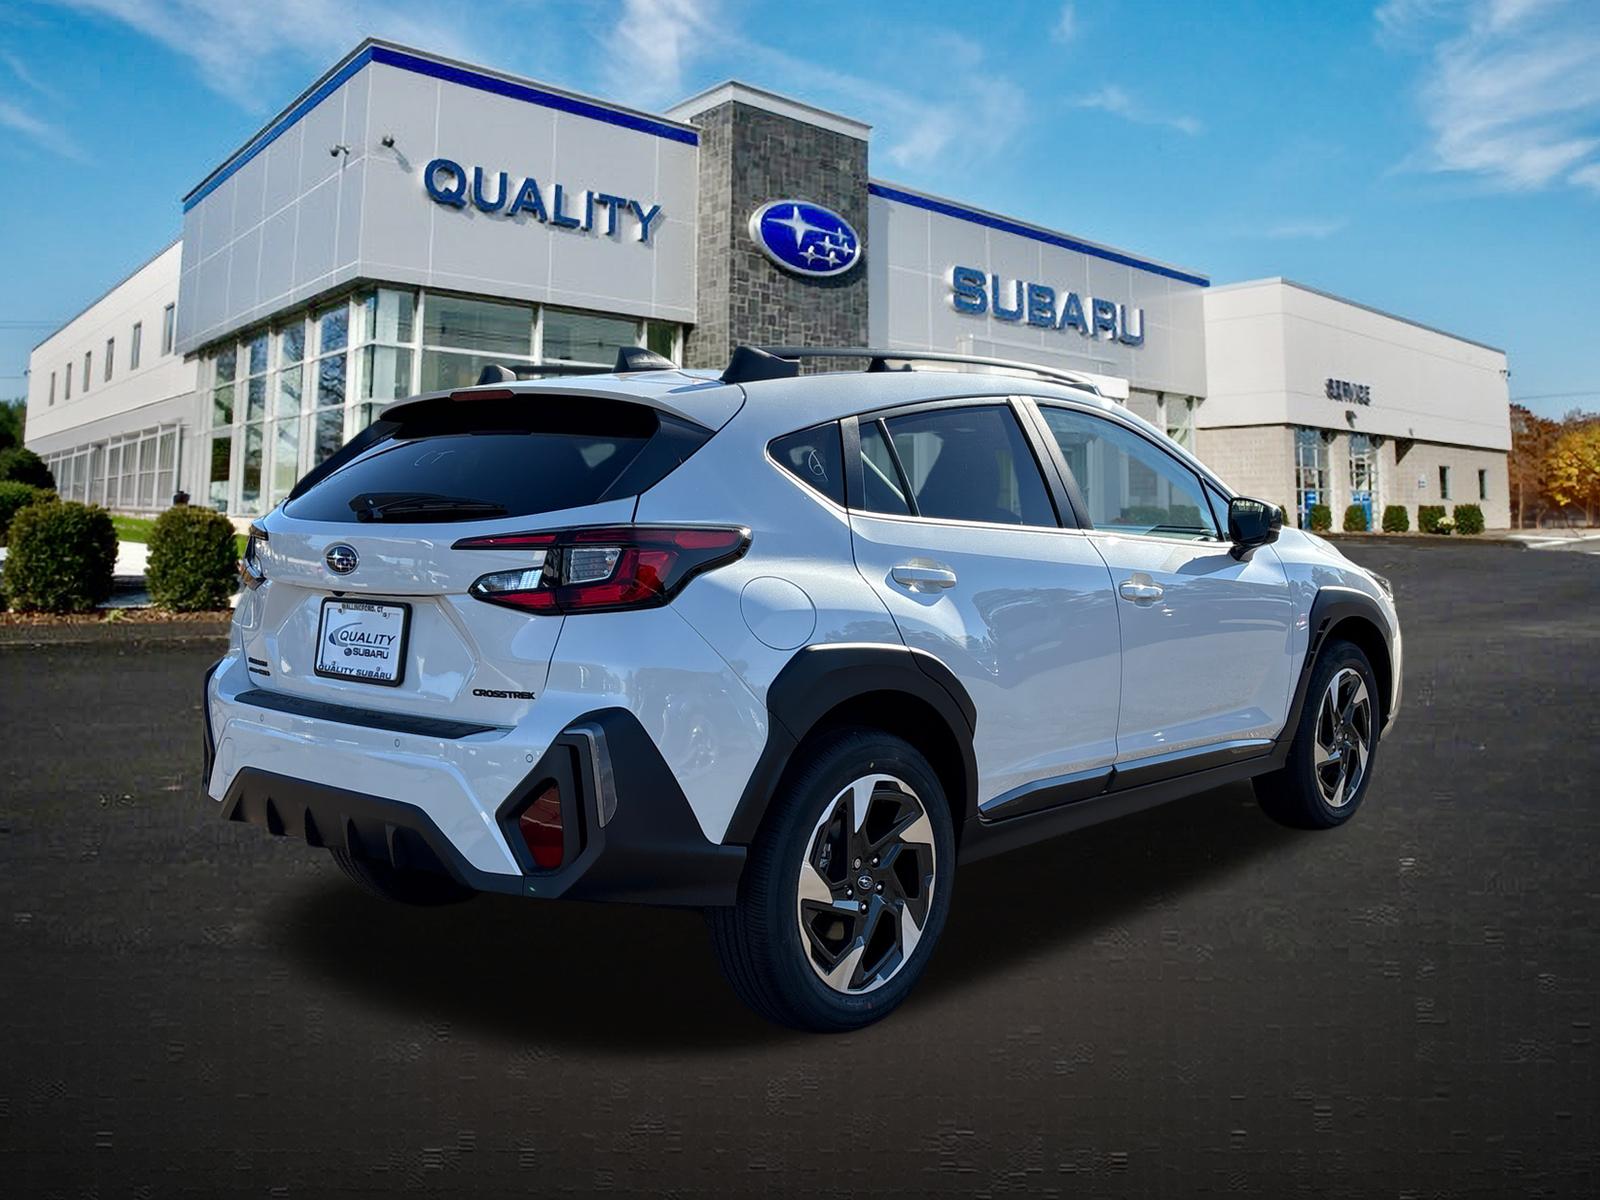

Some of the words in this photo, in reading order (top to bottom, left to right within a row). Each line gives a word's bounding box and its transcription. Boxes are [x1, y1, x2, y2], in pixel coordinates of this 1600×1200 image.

[424, 158, 661, 243] QUALITY
[950, 265, 1145, 347] SUBARU
[340, 630, 396, 646] QUALITY
[353, 647, 389, 660] SUBARU
[318, 664, 354, 675] QUALITY
[356, 669, 392, 680] SUBARU
[472, 689, 536, 700] CROSSTREK
